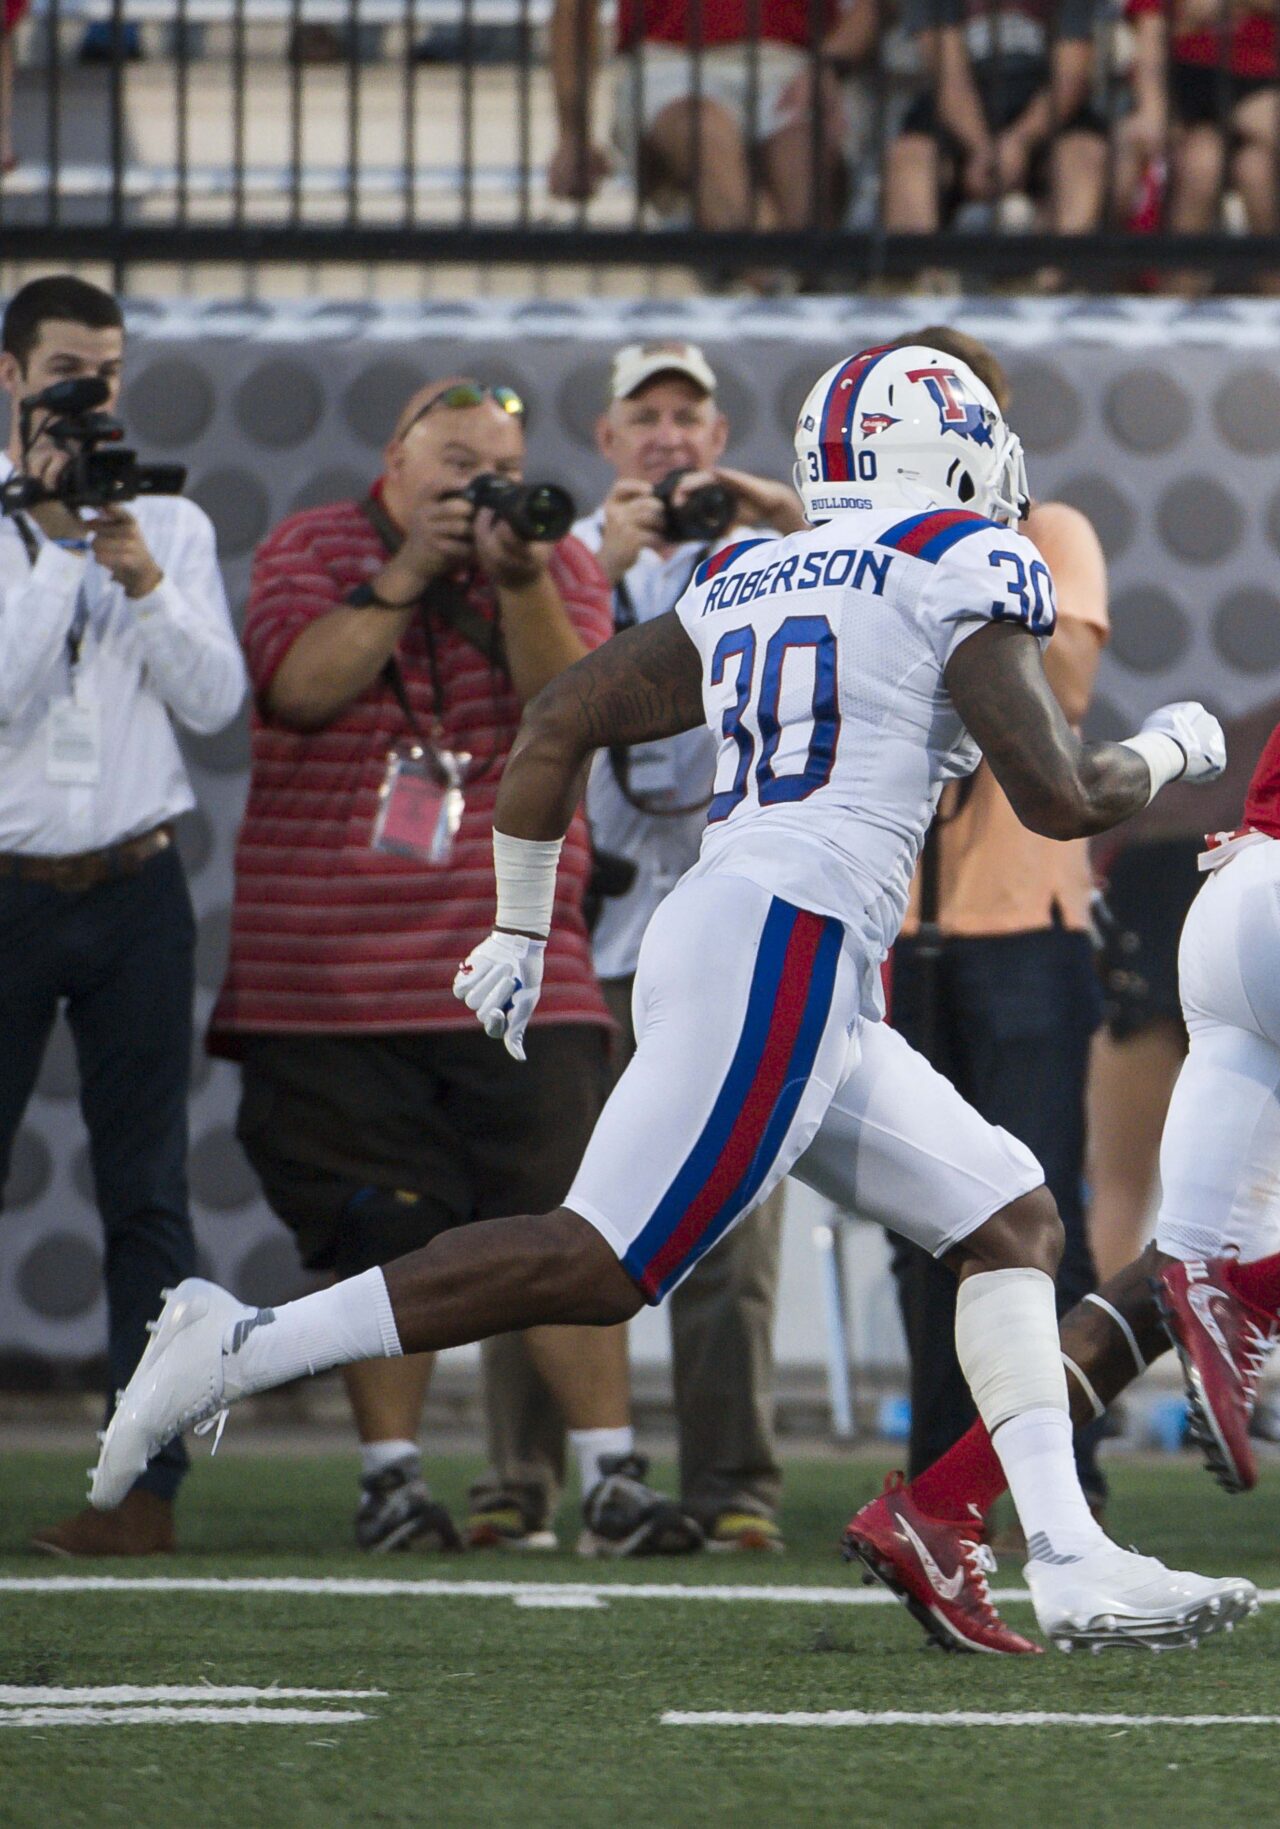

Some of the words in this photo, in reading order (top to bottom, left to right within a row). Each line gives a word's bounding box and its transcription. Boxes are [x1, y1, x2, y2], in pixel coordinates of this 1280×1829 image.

[811, 497, 873, 511] BULLDOGS
[700, 549, 894, 618] ROBERSON
[988, 549, 1056, 638] 30
[706, 614, 841, 826] 30
